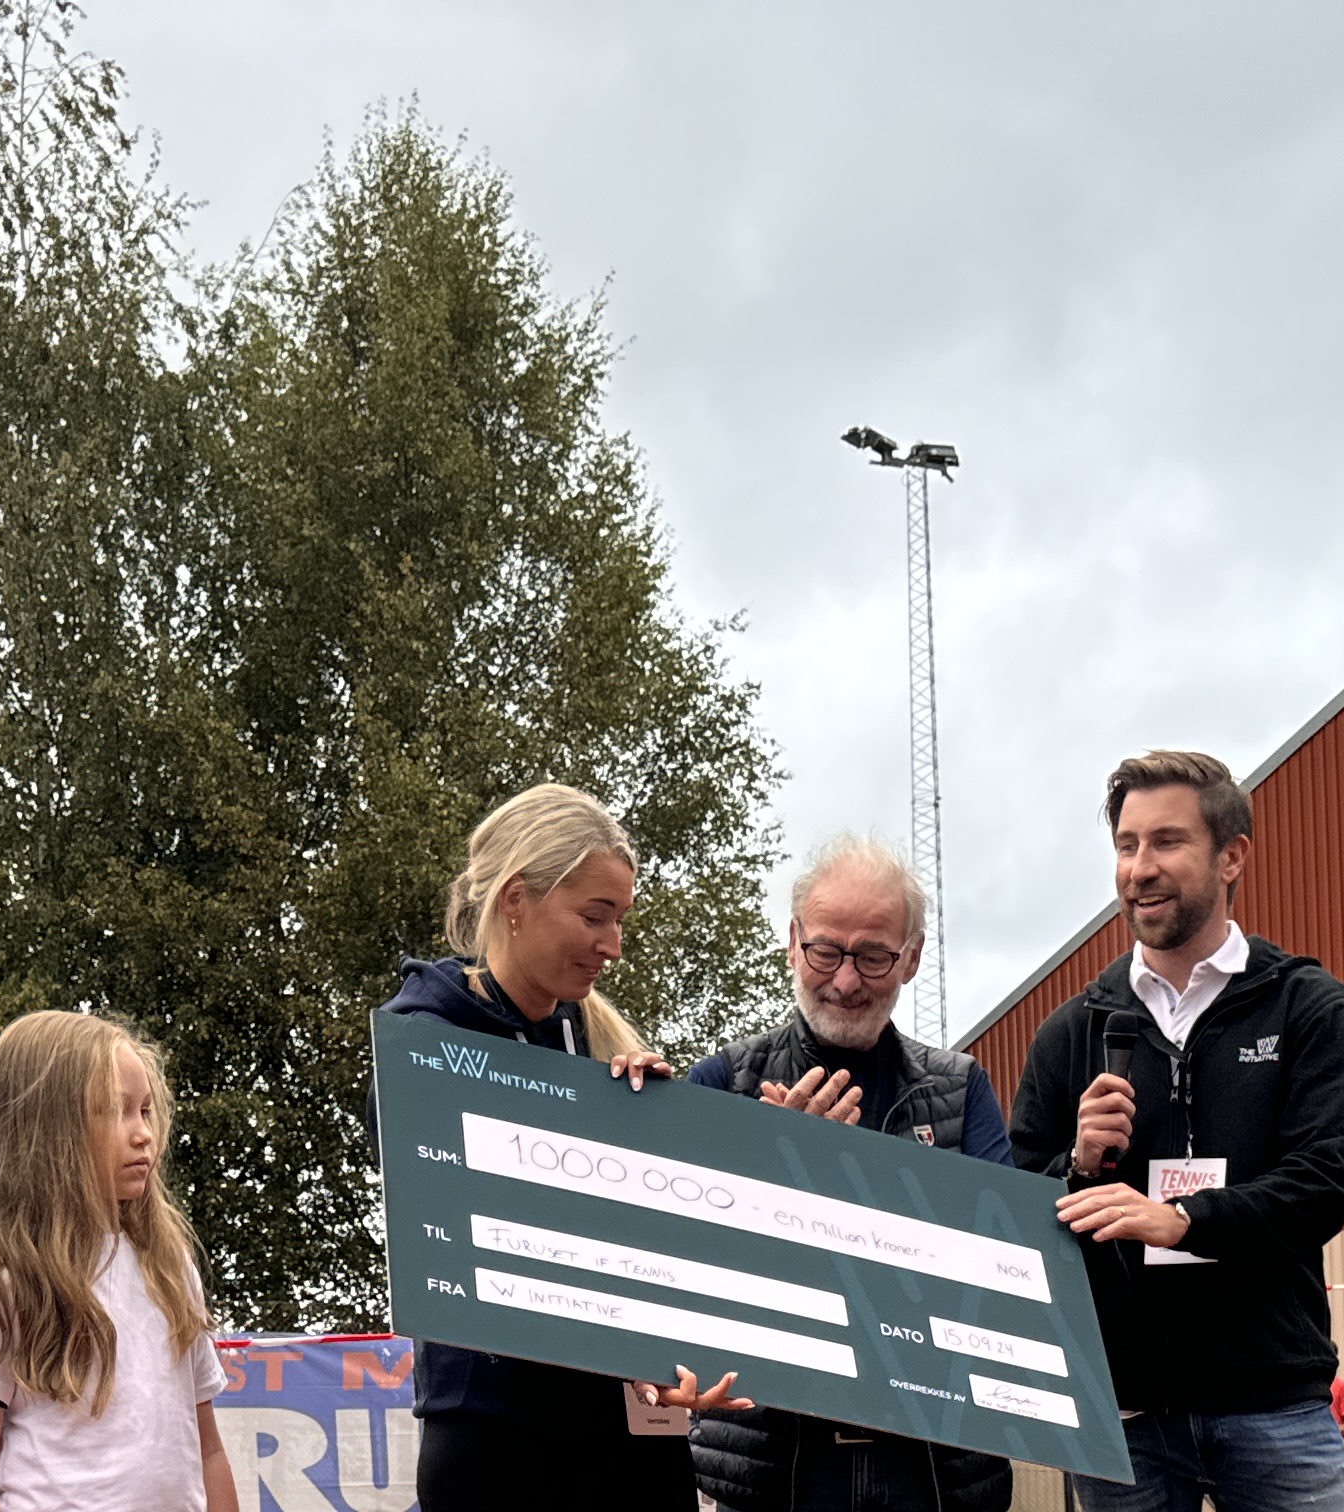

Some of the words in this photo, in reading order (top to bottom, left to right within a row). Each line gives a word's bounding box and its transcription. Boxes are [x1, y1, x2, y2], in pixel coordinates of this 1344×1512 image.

[409, 1051, 444, 1071] THE
[488, 1069, 577, 1101] INITIATIVE
[417, 1145, 462, 1166] SUM:
[422, 1224, 452, 1242] TIL
[774, 1209, 804, 1230] en
[872, 1230, 922, 1257] kroner
[487, 1227, 579, 1263] FURUSET
[618, 1260, 676, 1283] TENNIS
[996, 1262, 1032, 1281] NOK
[427, 1277, 467, 1298] FRA
[489, 1279, 516, 1298] W
[528, 1288, 623, 1319] INITIATIVE
[879, 1322, 925, 1344] DATO
